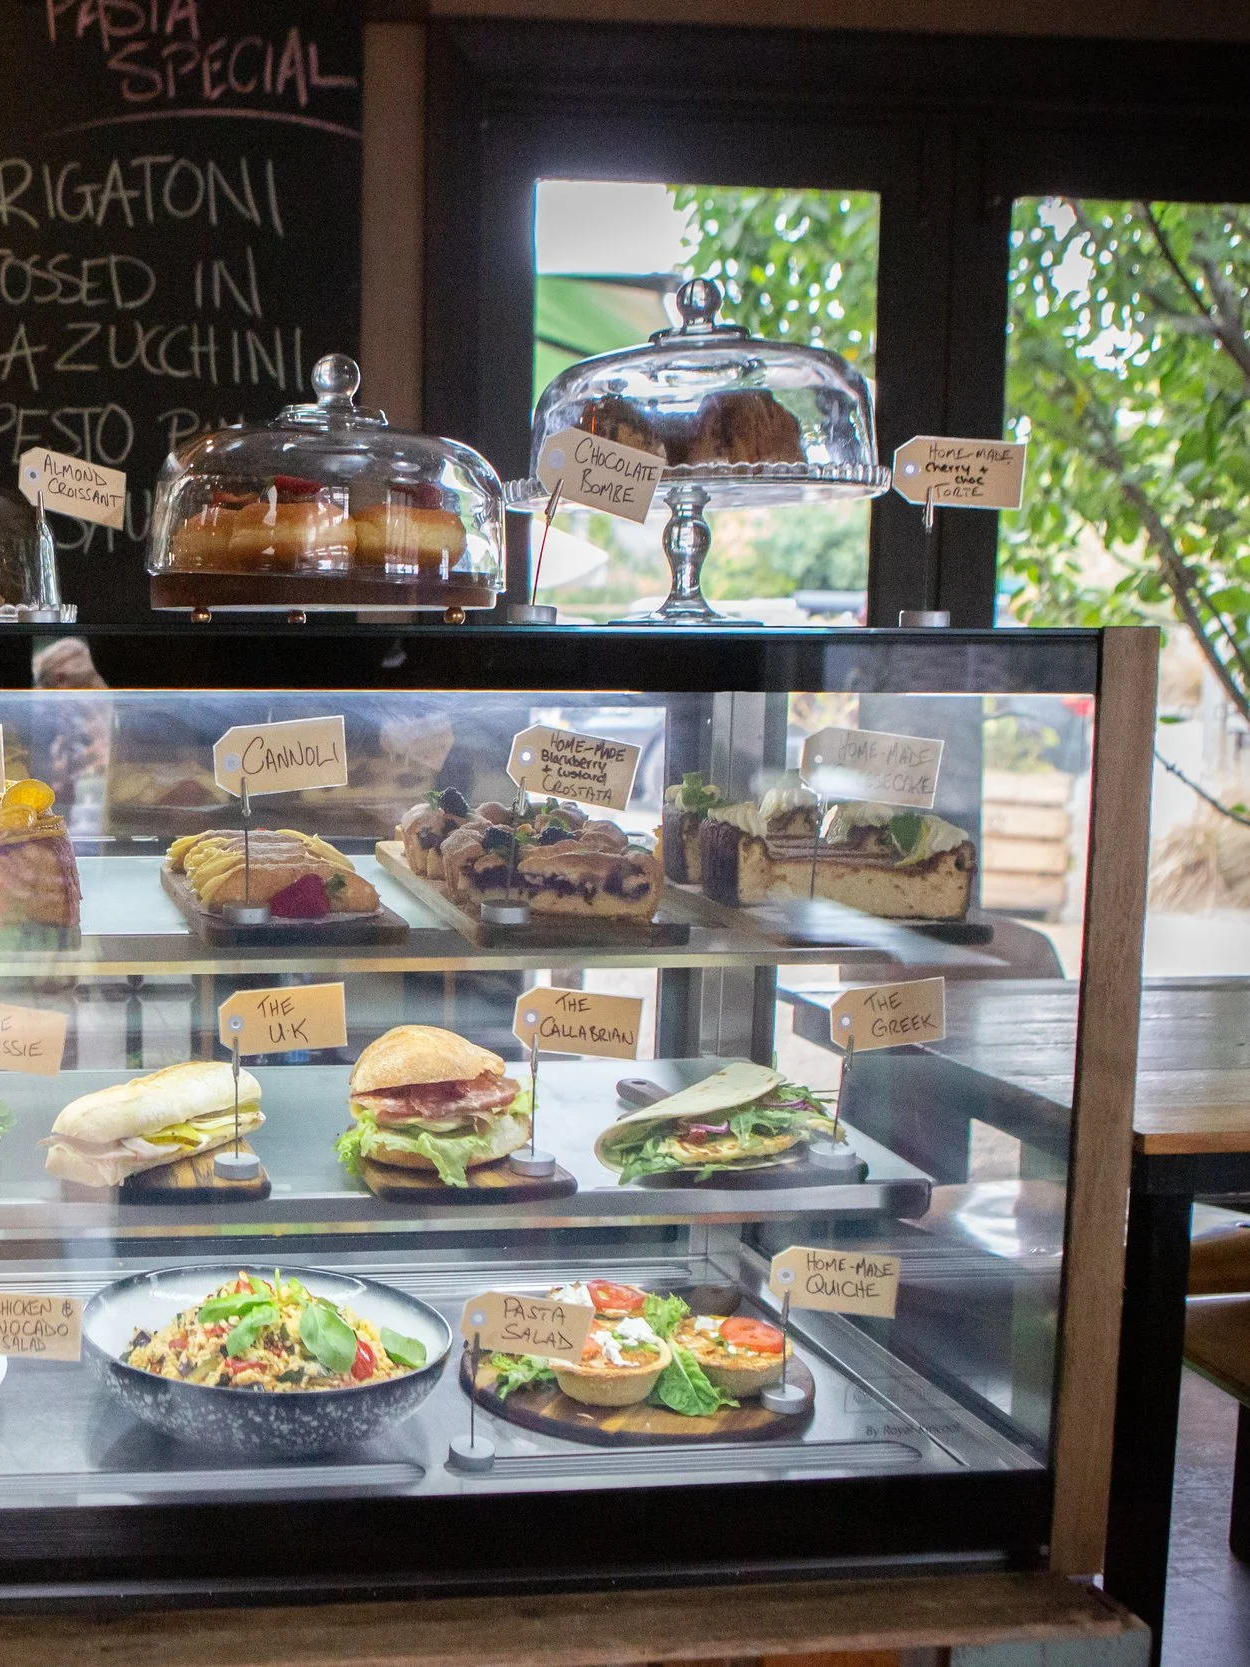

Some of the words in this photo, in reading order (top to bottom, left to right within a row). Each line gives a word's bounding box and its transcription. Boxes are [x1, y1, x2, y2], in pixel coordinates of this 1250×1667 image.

[107, 28, 358, 106] SPECIAL
[194, 247, 262, 318] IN
[53, 321, 304, 392] ZUCCHINI
[43, 453, 107, 486] ALMOND
[574, 437, 659, 482] CHOCOLATE
[47, 477, 124, 508] CROISSANT
[580, 468, 635, 503] BOMBE
[934, 482, 985, 499] TORTE
[242, 736, 340, 775] CANNOLI
[541, 749, 608, 772] Blackberry
[550, 730, 626, 763] HOME-MADE
[542, 774, 613, 804] CROSTATA
[257, 994, 295, 1018] THE
[555, 992, 591, 1012] THE
[863, 992, 902, 1012] THE
[540, 1016, 634, 1045] CALLABRIAN
[871, 1013, 938, 1037] GREEK
[806, 1251, 894, 1278] HOME-MADE
[806, 1273, 880, 1299] QUICHE
[504, 1297, 566, 1325] PASTA
[2, 1335, 46, 1352] SALAD
[502, 1323, 573, 1350] SALAD
